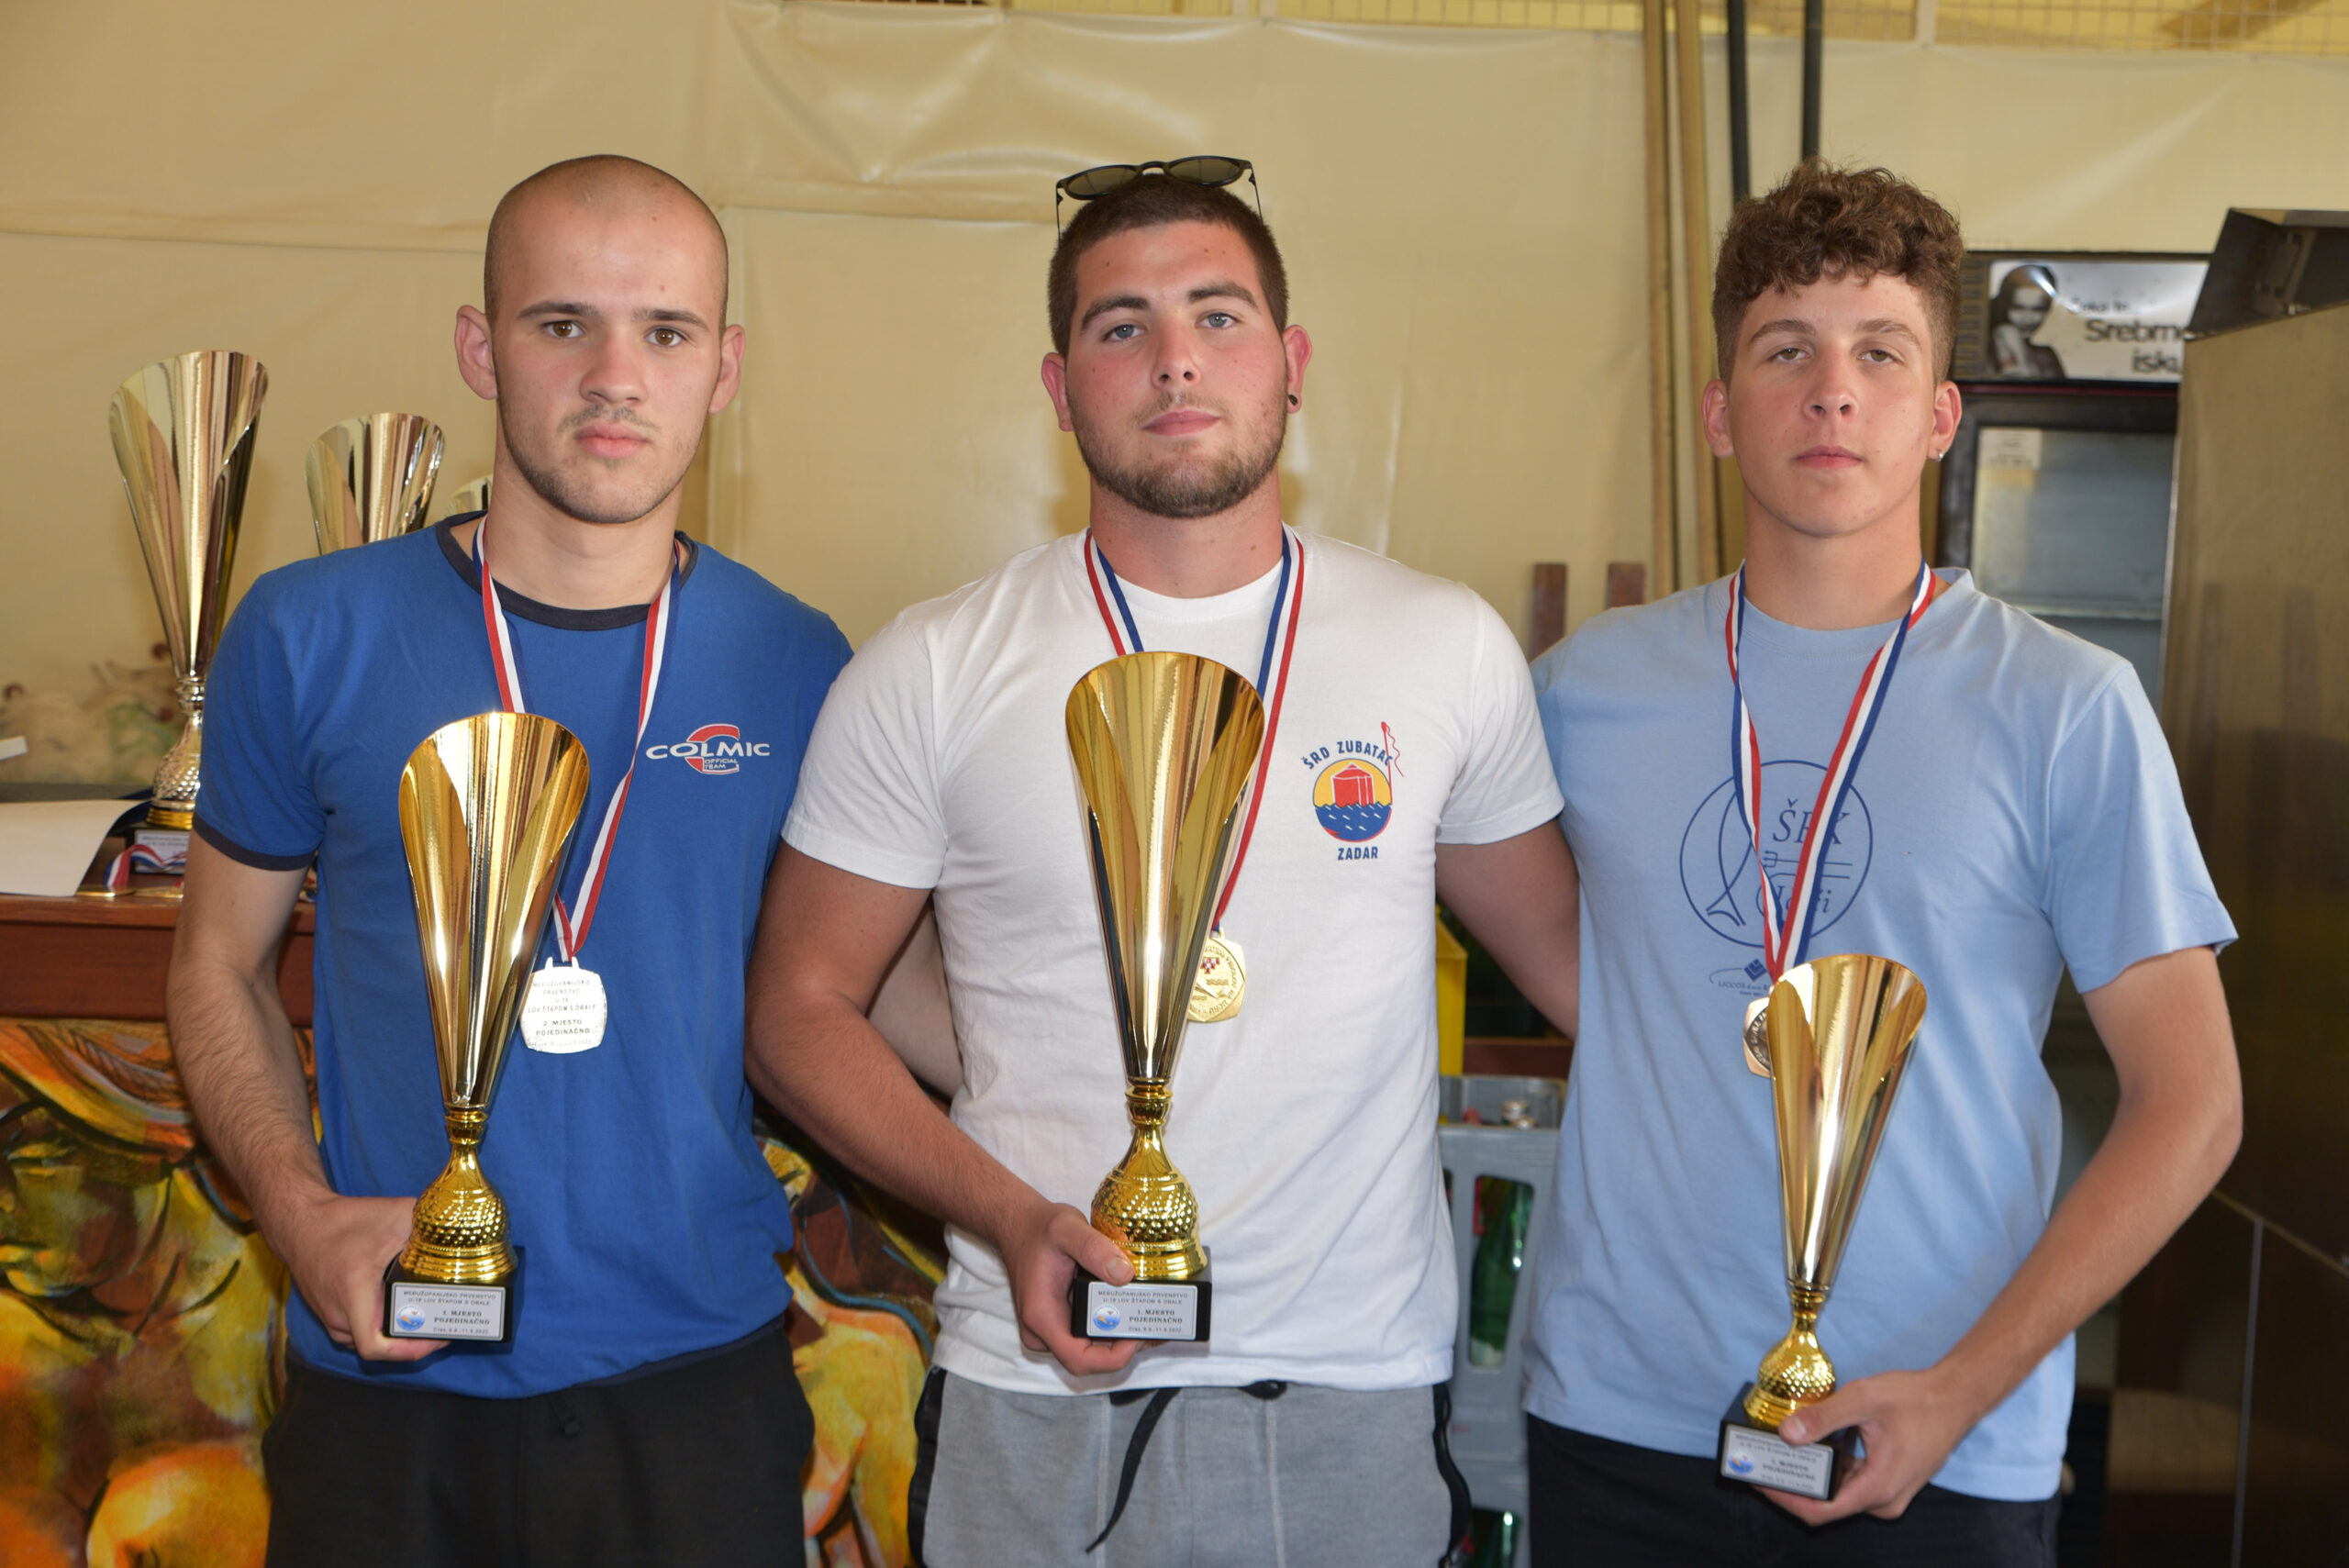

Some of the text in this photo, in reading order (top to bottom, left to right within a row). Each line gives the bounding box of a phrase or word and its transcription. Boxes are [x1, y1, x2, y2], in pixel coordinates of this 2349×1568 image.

[645, 741, 771, 760] COLMIC
[1300, 740, 1393, 770] ŠRD ZUBATAC
[1337, 846, 1378, 861] ZADAR
[551, 1018, 583, 1027] MJESTO
[535, 1027, 591, 1037] POJEDINAČNO
[1144, 1308, 1175, 1317] MJESTO
[433, 1316, 491, 1326] POJEDINAČNO
[1129, 1315, 1184, 1325] POJEDINAČNO
